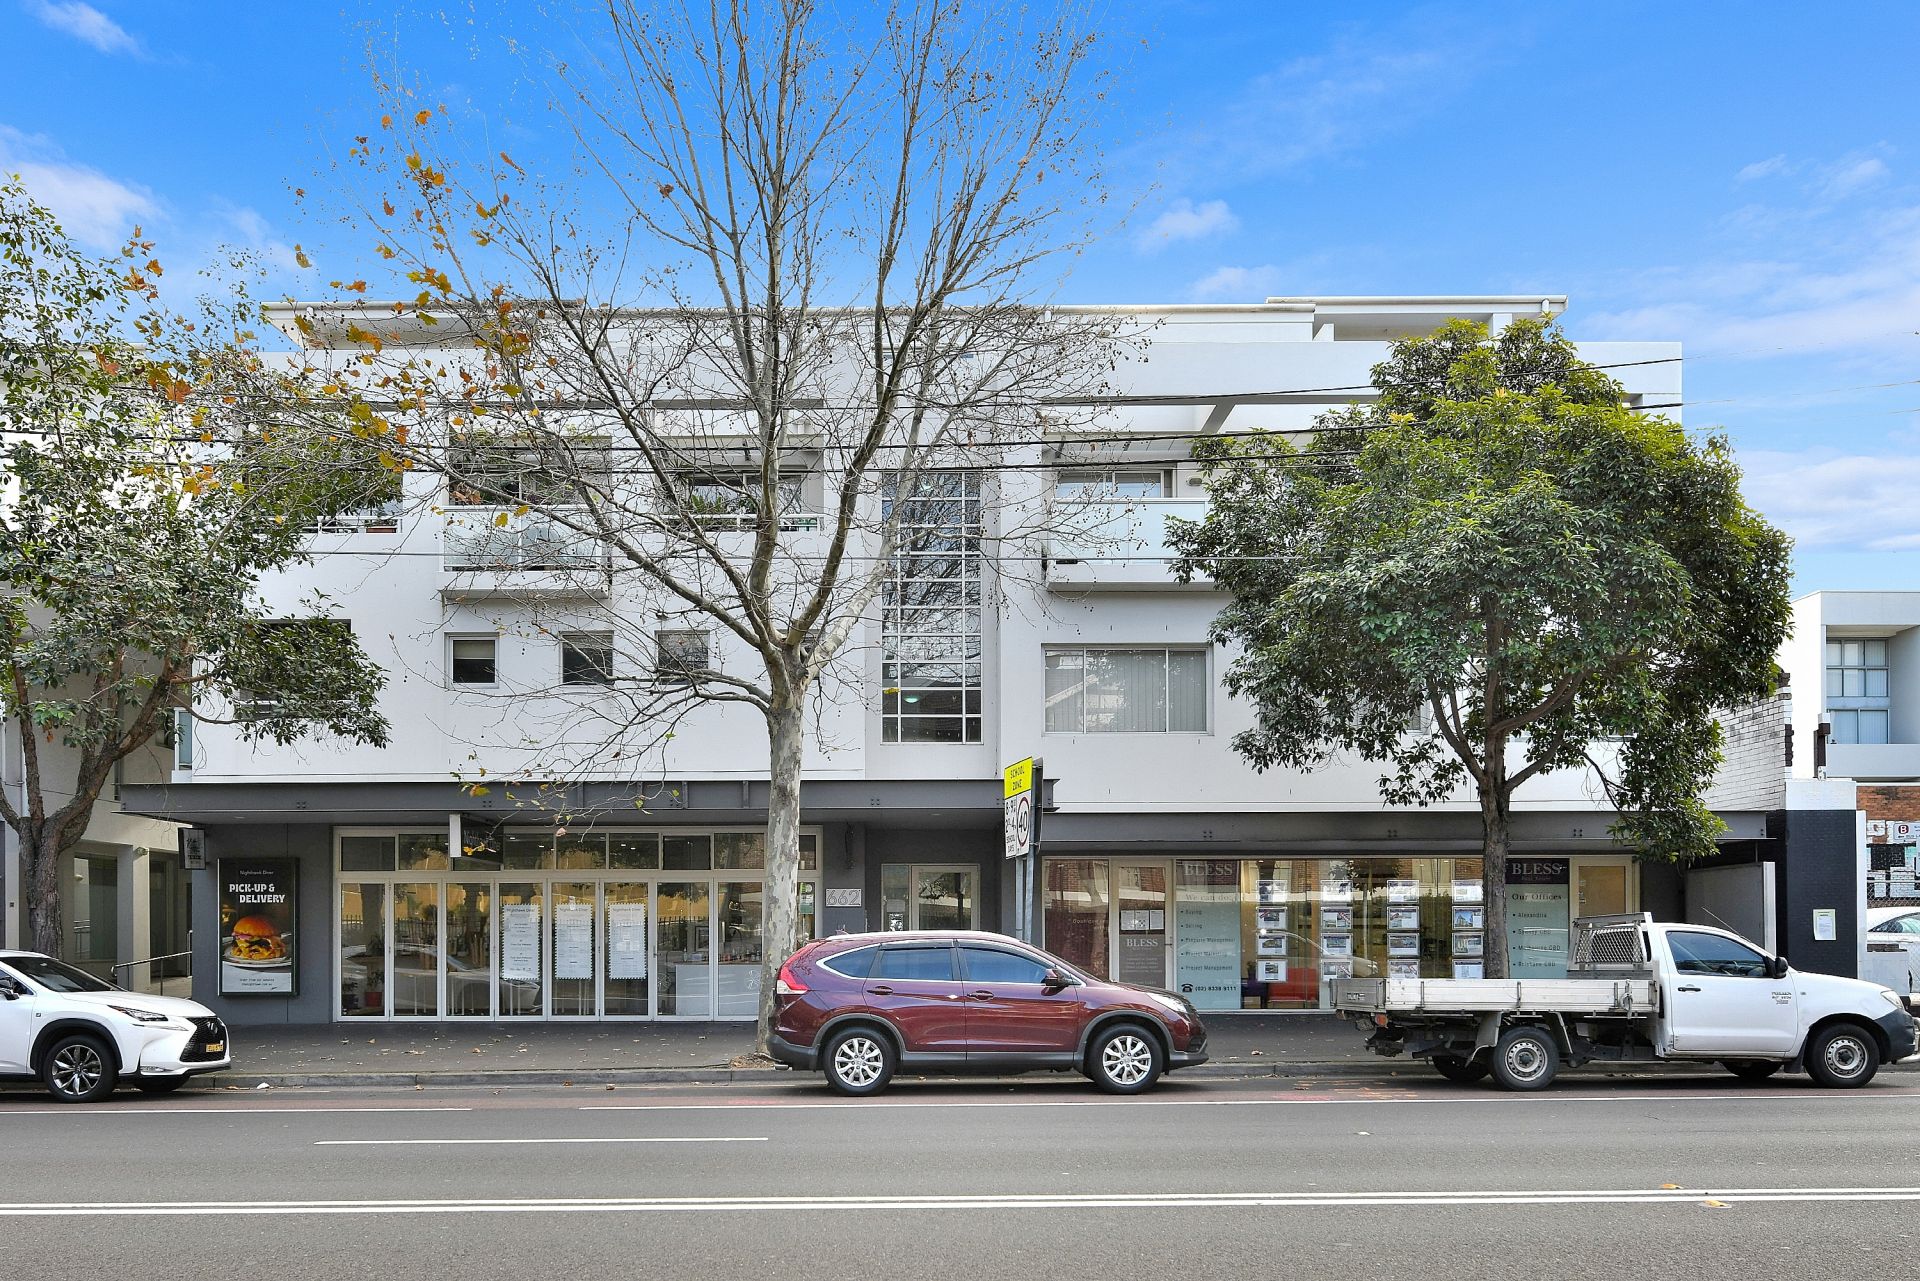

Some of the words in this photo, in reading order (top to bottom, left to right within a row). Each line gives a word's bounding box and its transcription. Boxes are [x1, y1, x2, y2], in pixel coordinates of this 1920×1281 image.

[1010, 765, 1025, 779] SCHOOL
[1012, 779, 1022, 791] ZONE
[1019, 811, 1027, 832] 40
[1184, 863, 1233, 876] BLESS
[1511, 863, 1561, 875] BLESS
[229, 883, 267, 893] PICK-UP
[268, 883, 275, 893] &
[240, 894, 285, 903] DELIVERY
[827, 889, 860, 906] 662
[1126, 939, 1159, 947] BLESS
